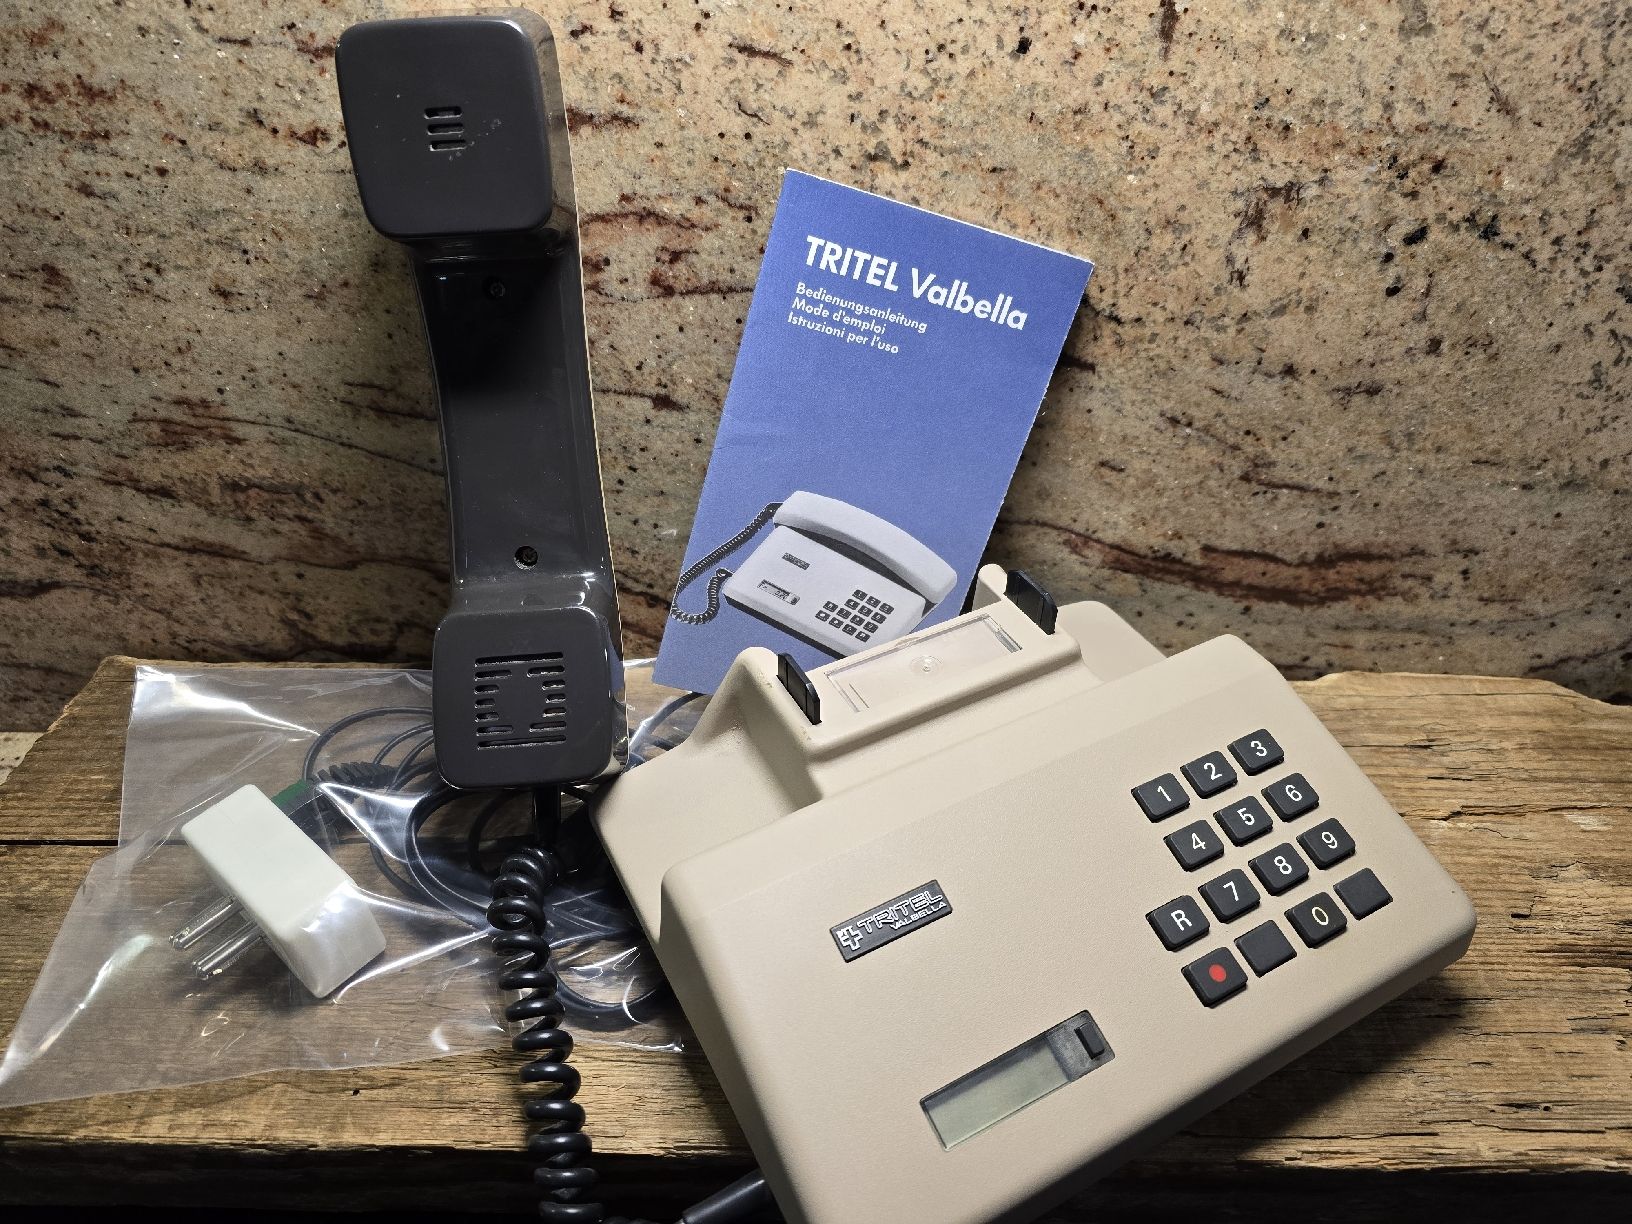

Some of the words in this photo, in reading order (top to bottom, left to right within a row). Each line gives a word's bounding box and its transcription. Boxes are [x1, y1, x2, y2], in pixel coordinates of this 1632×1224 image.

[806, 235, 899, 292] TRITEL
[911, 267, 1028, 330] Valbella
[791, 297, 830, 318] Mode
[832, 310, 887, 336] d'emploi
[796, 282, 927, 334] Bedienungsanleitung
[787, 311, 845, 338] Istruzioni
[846, 331, 869, 346] per
[870, 336, 899, 354] l'uso
[1156, 785, 1172, 802] 1
[1203, 762, 1222, 780] 2
[1250, 740, 1267, 757] 3
[1191, 832, 1206, 850] 4
[1236, 807, 1255, 826] 5
[1285, 784, 1302, 802] 6
[1170, 909, 1192, 931] R
[1222, 881, 1239, 902] 7
[1273, 855, 1292, 875] 8
[1321, 831, 1338, 849] 9
[857, 891, 943, 933] TRITEL
[889, 901, 947, 930] VALBELLA
[1311, 906, 1329, 926] 0
